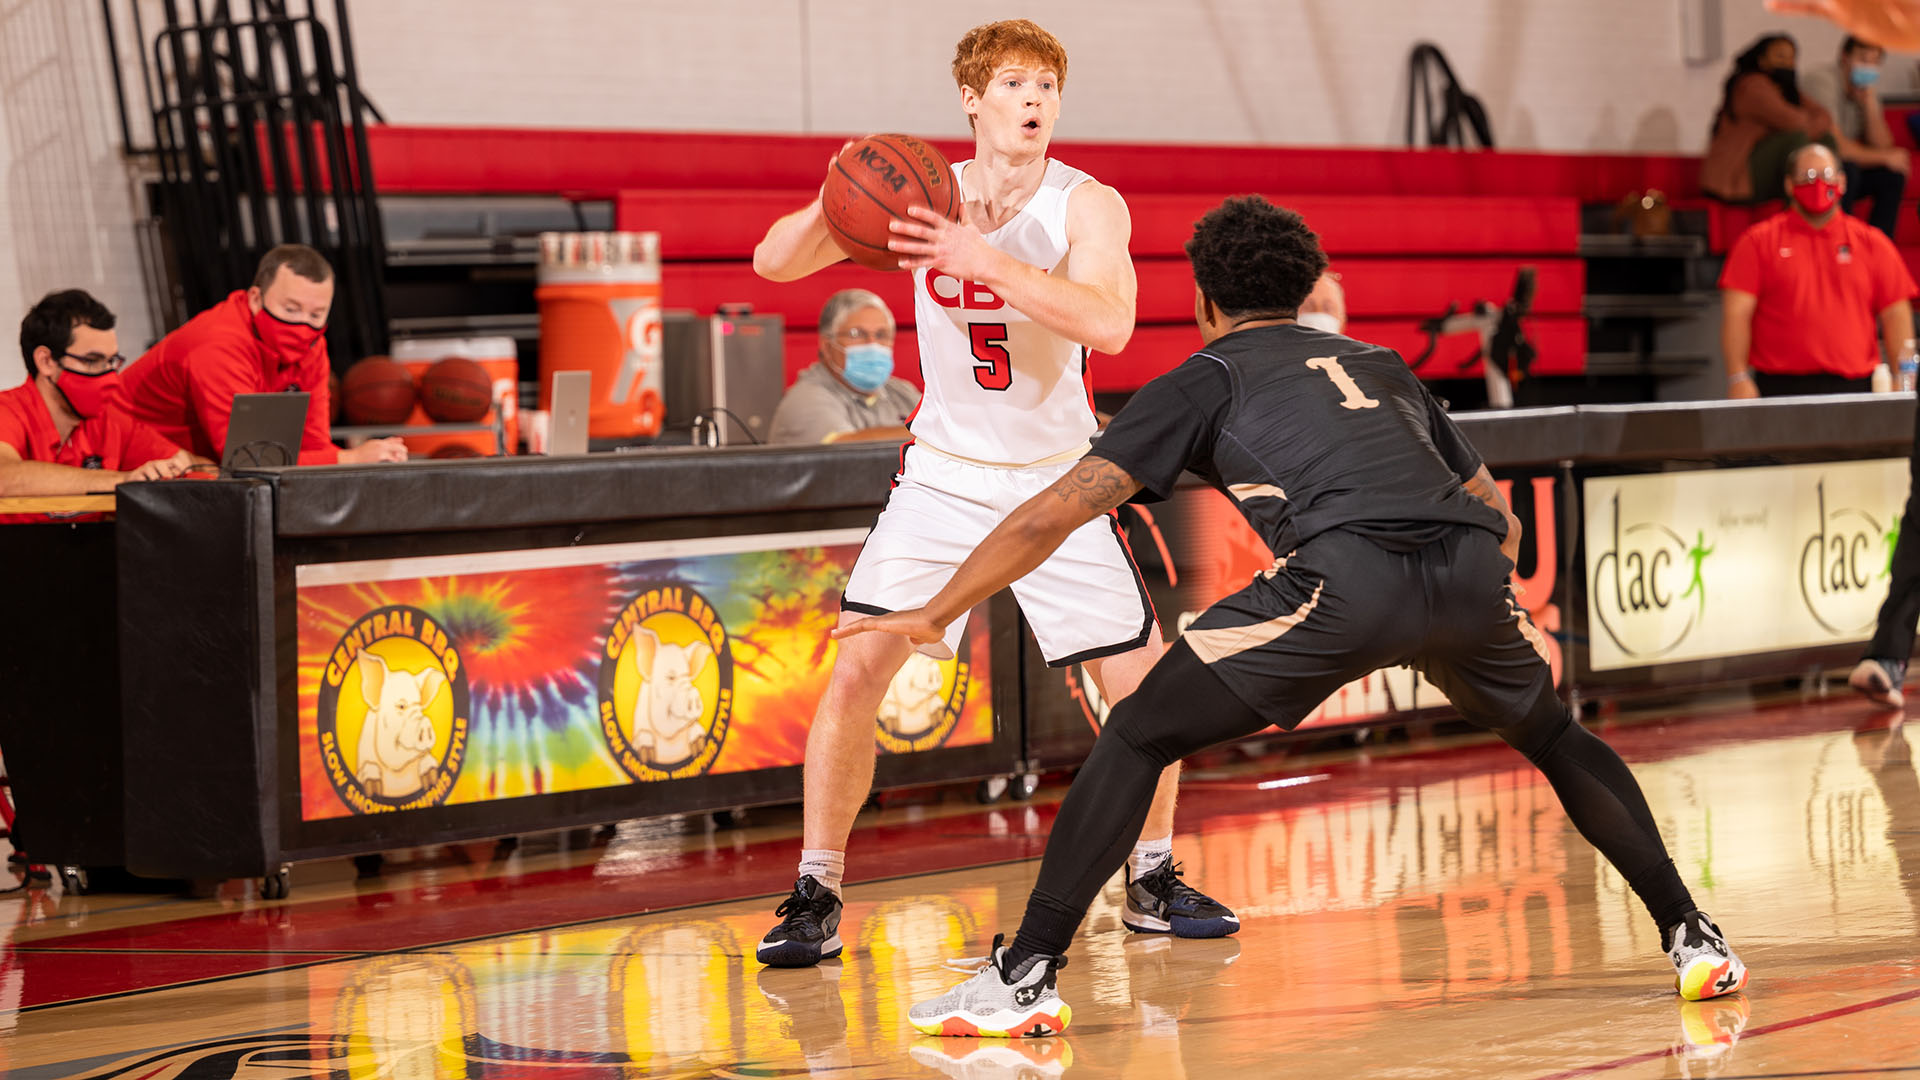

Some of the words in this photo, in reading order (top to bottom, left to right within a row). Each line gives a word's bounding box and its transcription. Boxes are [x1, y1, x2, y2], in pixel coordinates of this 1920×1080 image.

[853, 146, 909, 193] NCAA
[925, 267, 1049, 311] CB
[968, 322, 1012, 391] 5
[1305, 356, 1380, 410] 1
[327, 611, 415, 687] CENTRAL
[420, 619, 459, 682] BBQ
[607, 587, 684, 660] CENTRAL
[689, 594, 725, 656] BBQ
[600, 701, 625, 753] SLOW
[322, 731, 347, 787] SLOW
